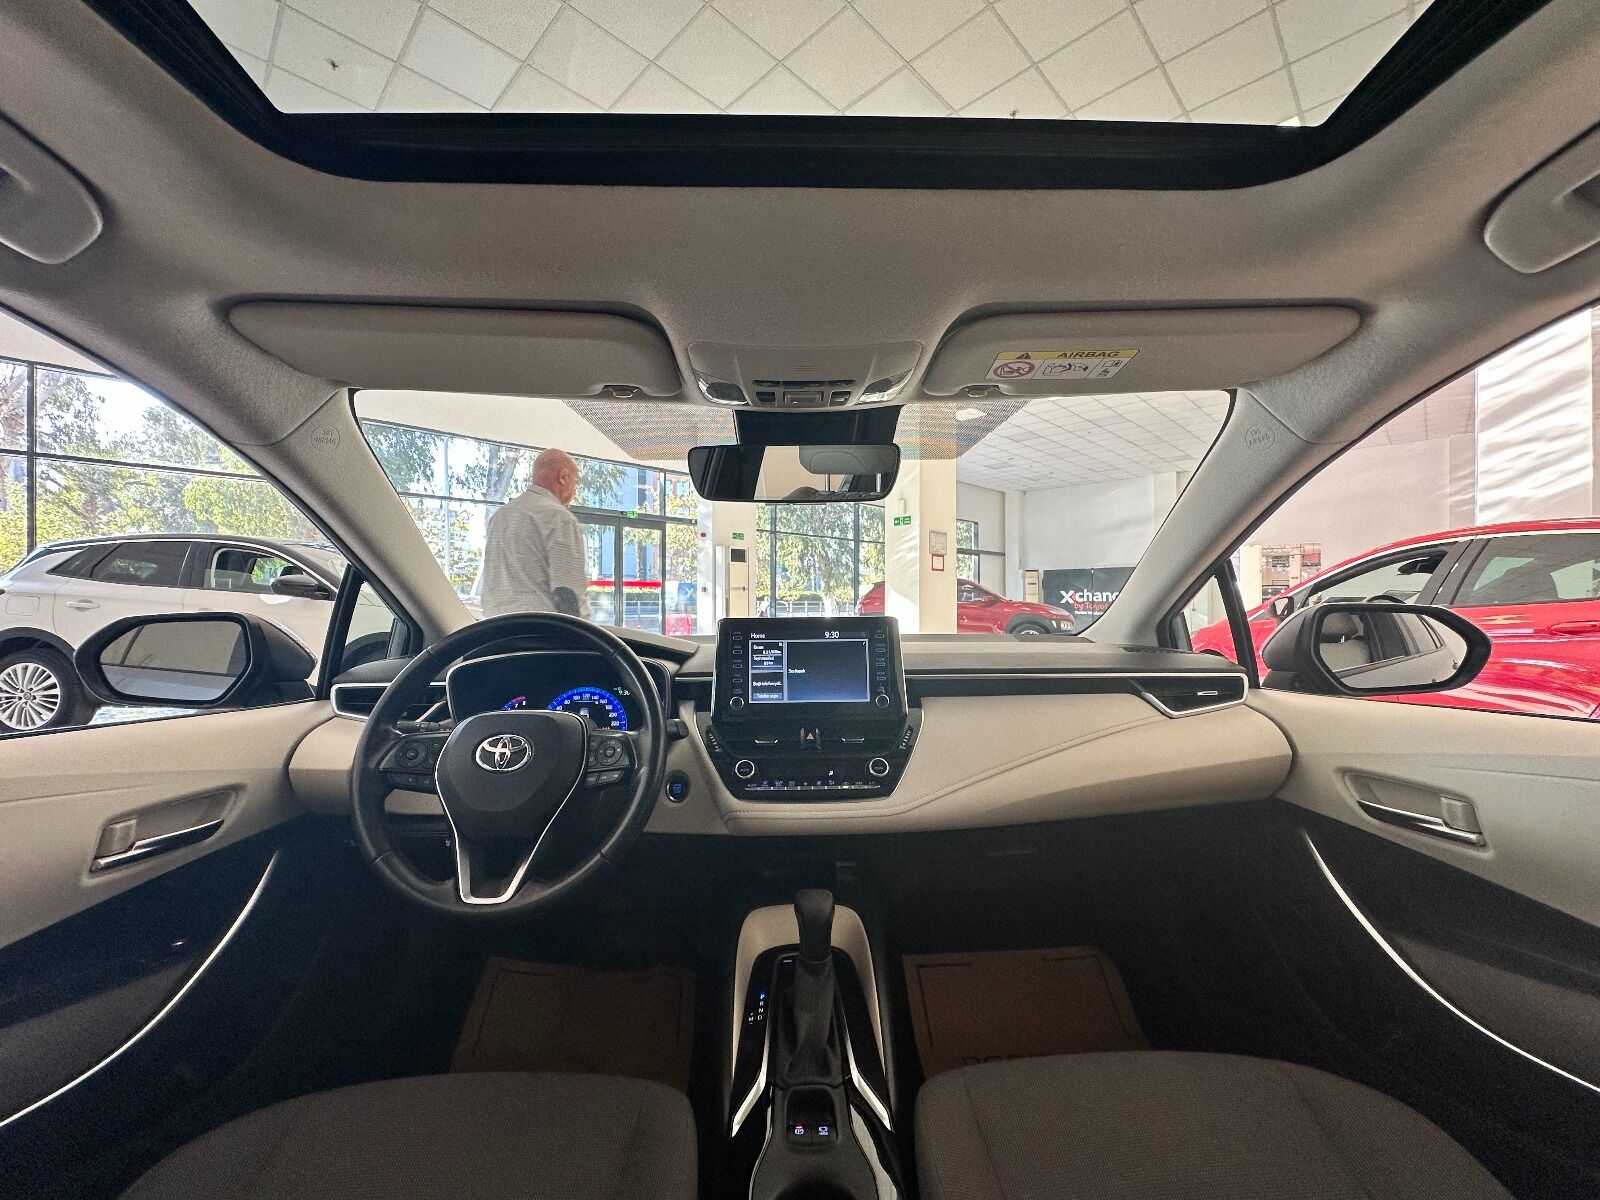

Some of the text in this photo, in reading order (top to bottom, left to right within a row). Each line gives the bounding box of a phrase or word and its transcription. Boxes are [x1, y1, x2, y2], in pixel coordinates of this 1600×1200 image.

[1056, 351, 1120, 359] AIRBAG
[1074, 602, 1084, 610] by
[824, 631, 840, 639] 9:30
